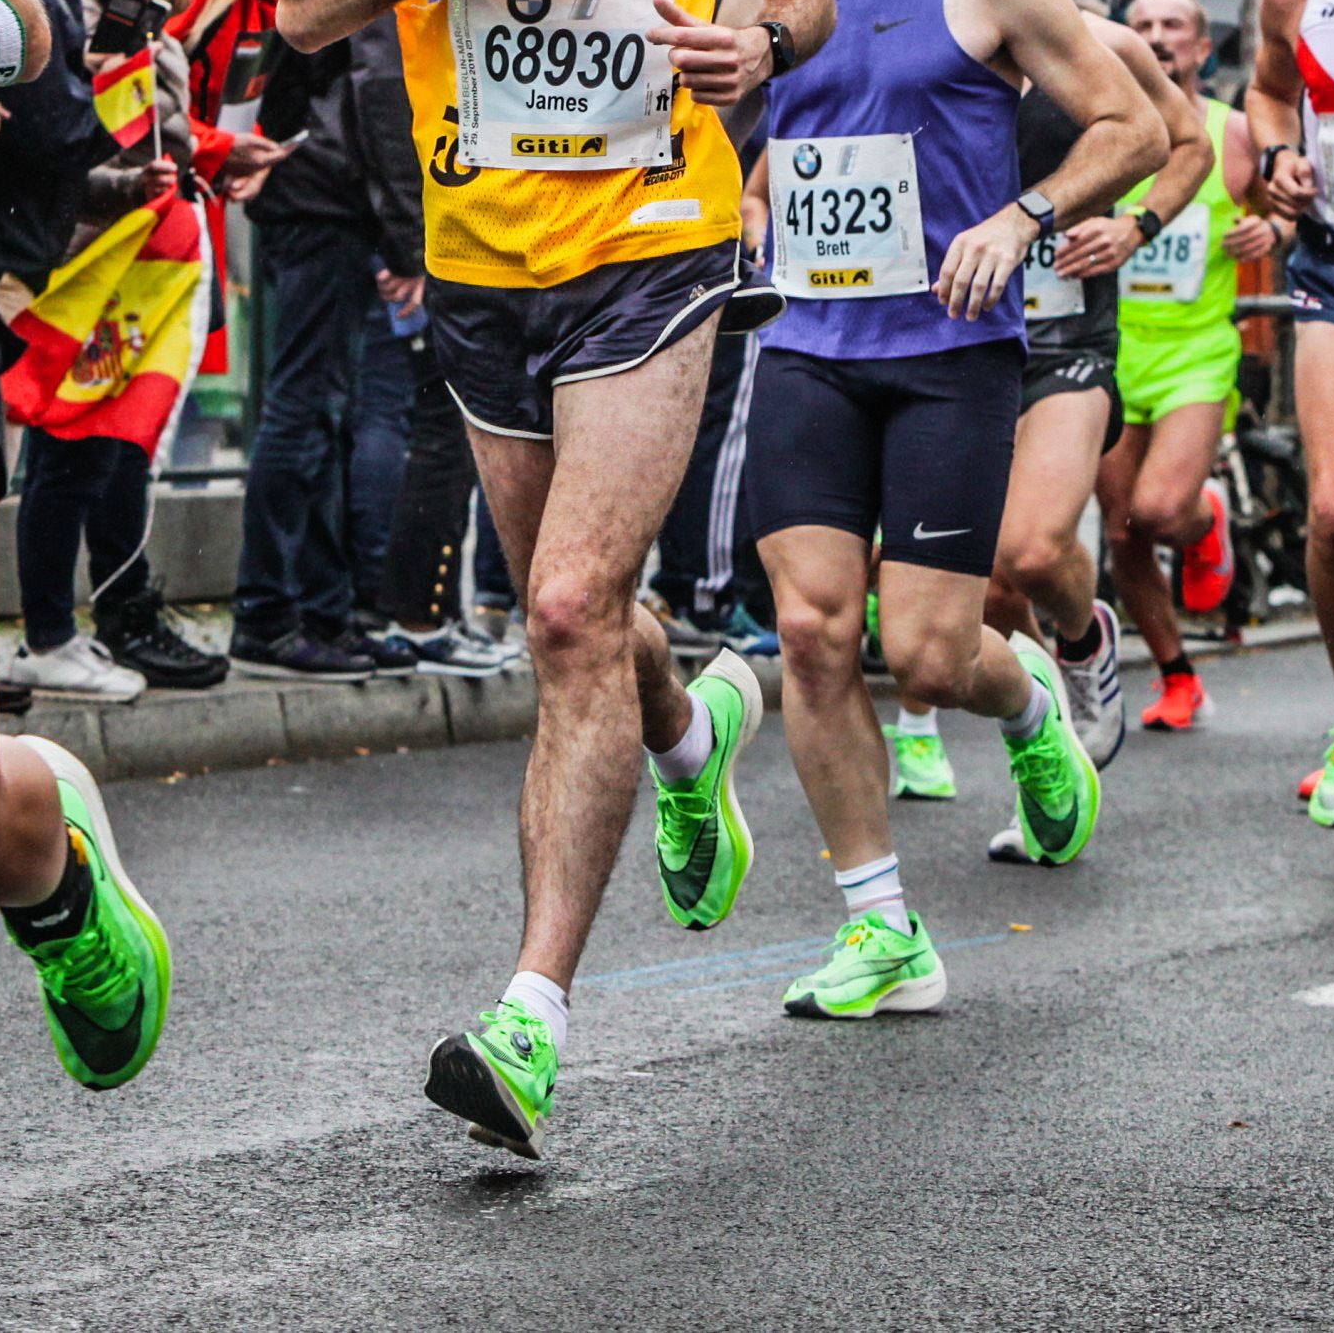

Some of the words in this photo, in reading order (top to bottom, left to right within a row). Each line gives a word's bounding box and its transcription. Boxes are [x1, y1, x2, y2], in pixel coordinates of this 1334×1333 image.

[467, 52, 477, 76] 2019
[484, 24, 646, 91] 68930
[469, 77, 479, 128] September
[526, 89, 588, 113] James
[516, 138, 570, 154] Giti
[898, 180, 909, 194] B
[786, 186, 892, 237] 41323
[817, 240, 851, 256] Brett
[810, 272, 845, 285] Giti
